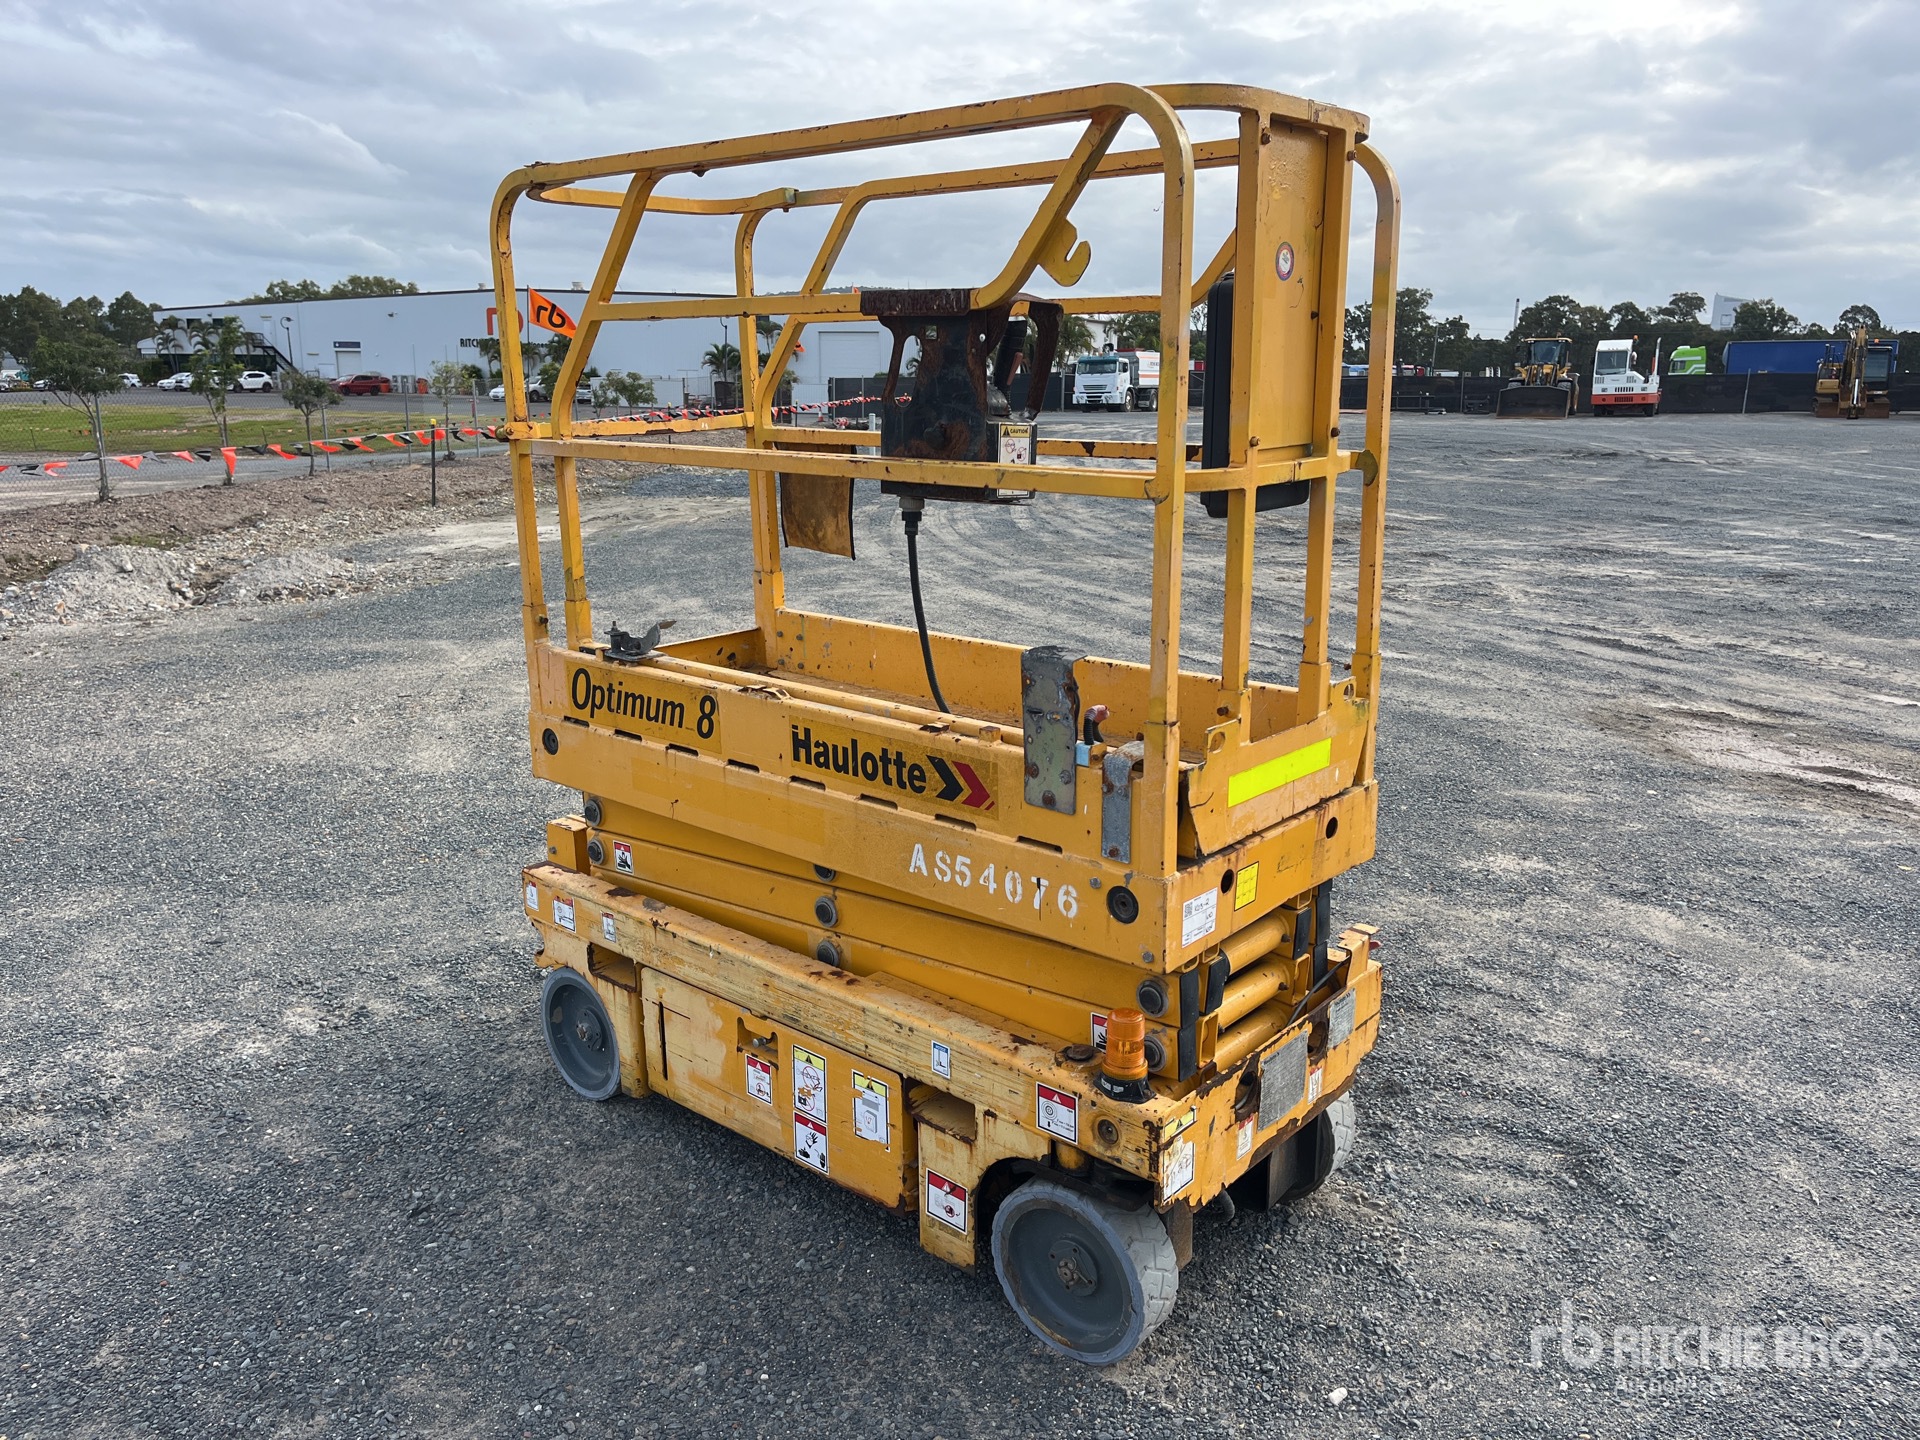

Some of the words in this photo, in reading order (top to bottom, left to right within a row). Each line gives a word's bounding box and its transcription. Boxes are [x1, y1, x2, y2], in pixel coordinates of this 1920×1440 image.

[536, 303, 567, 328] rb
[571, 667, 686, 730] Optimum
[696, 694, 717, 740] 8
[791, 725, 927, 794] Haulotte
[908, 842, 1080, 919] AS54076
